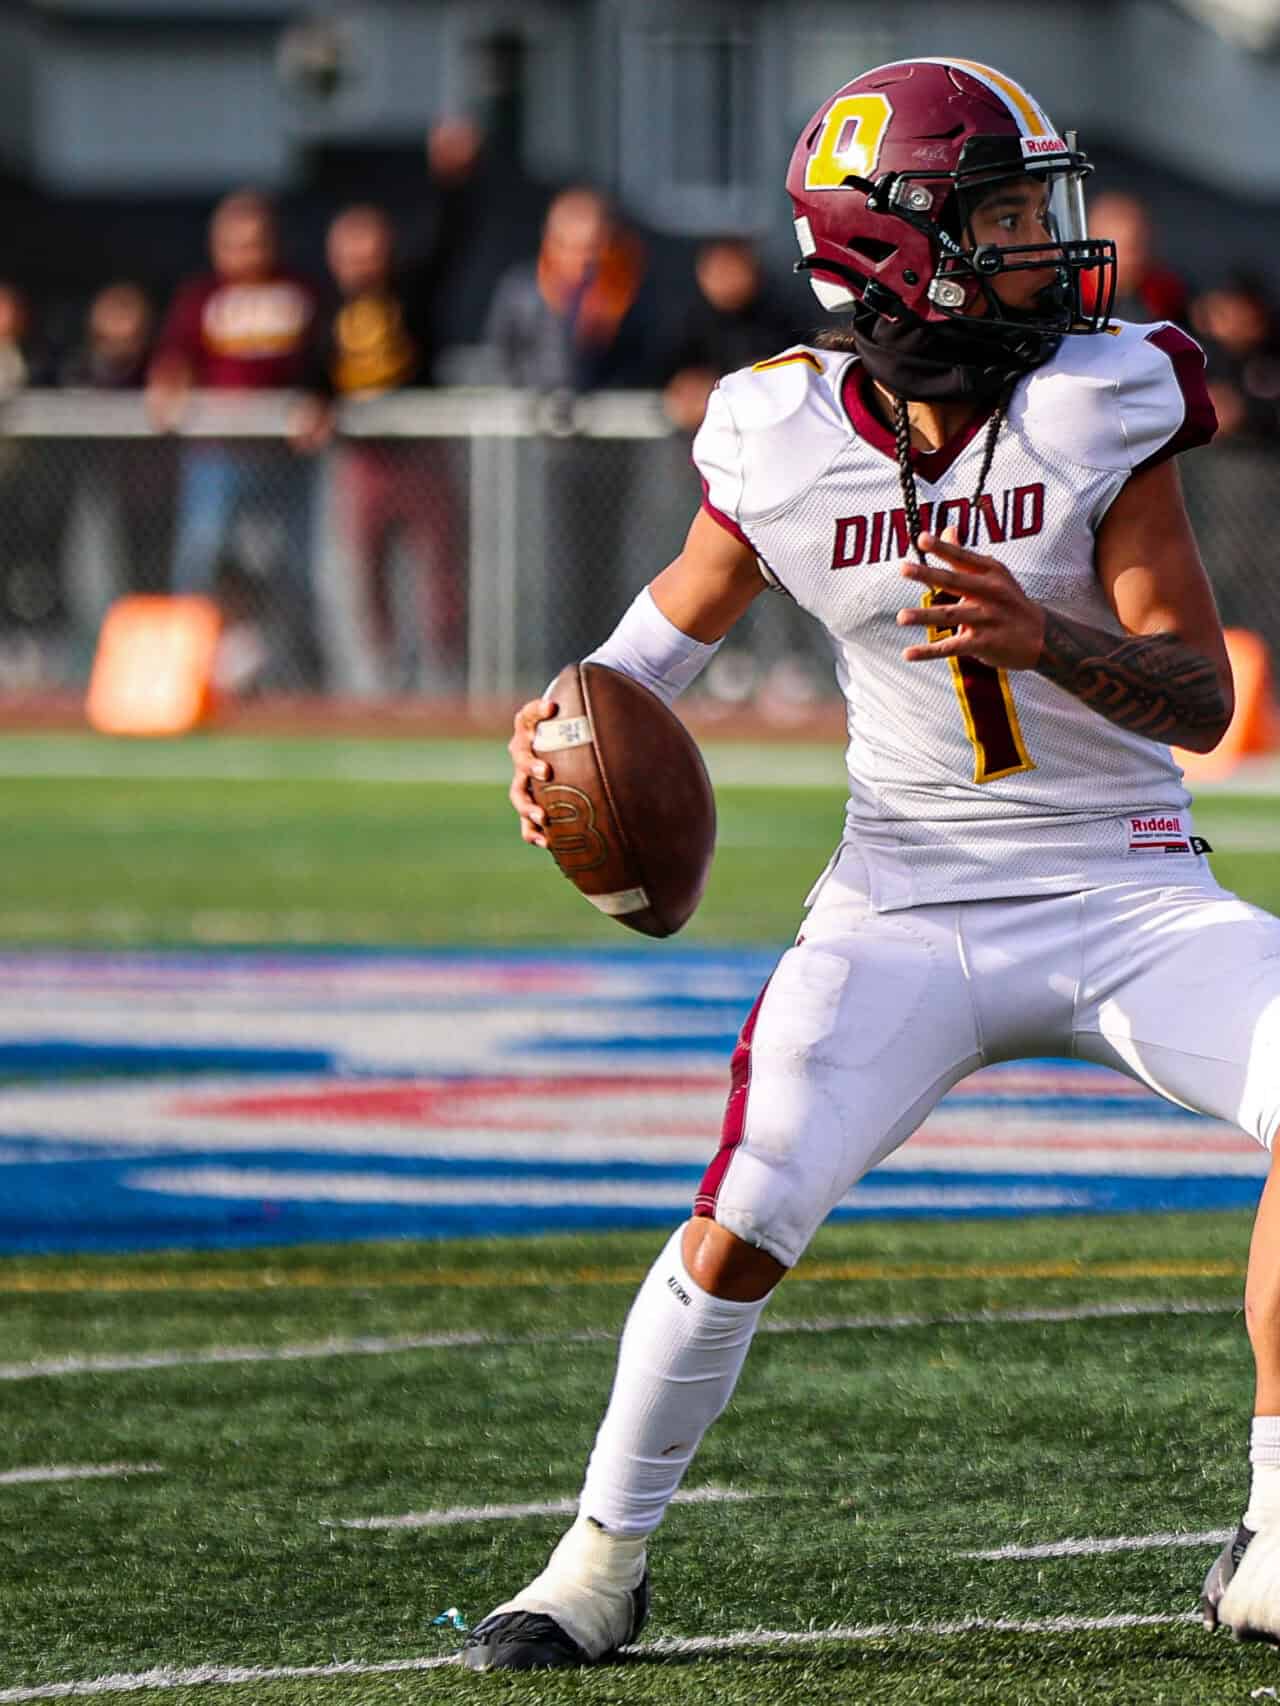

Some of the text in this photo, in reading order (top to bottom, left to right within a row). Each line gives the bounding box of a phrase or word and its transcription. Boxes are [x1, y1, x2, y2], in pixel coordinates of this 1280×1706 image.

[805, 93, 894, 191] D
[830, 482, 1045, 571] DIMOND
[1131, 816, 1182, 832] Riddell
